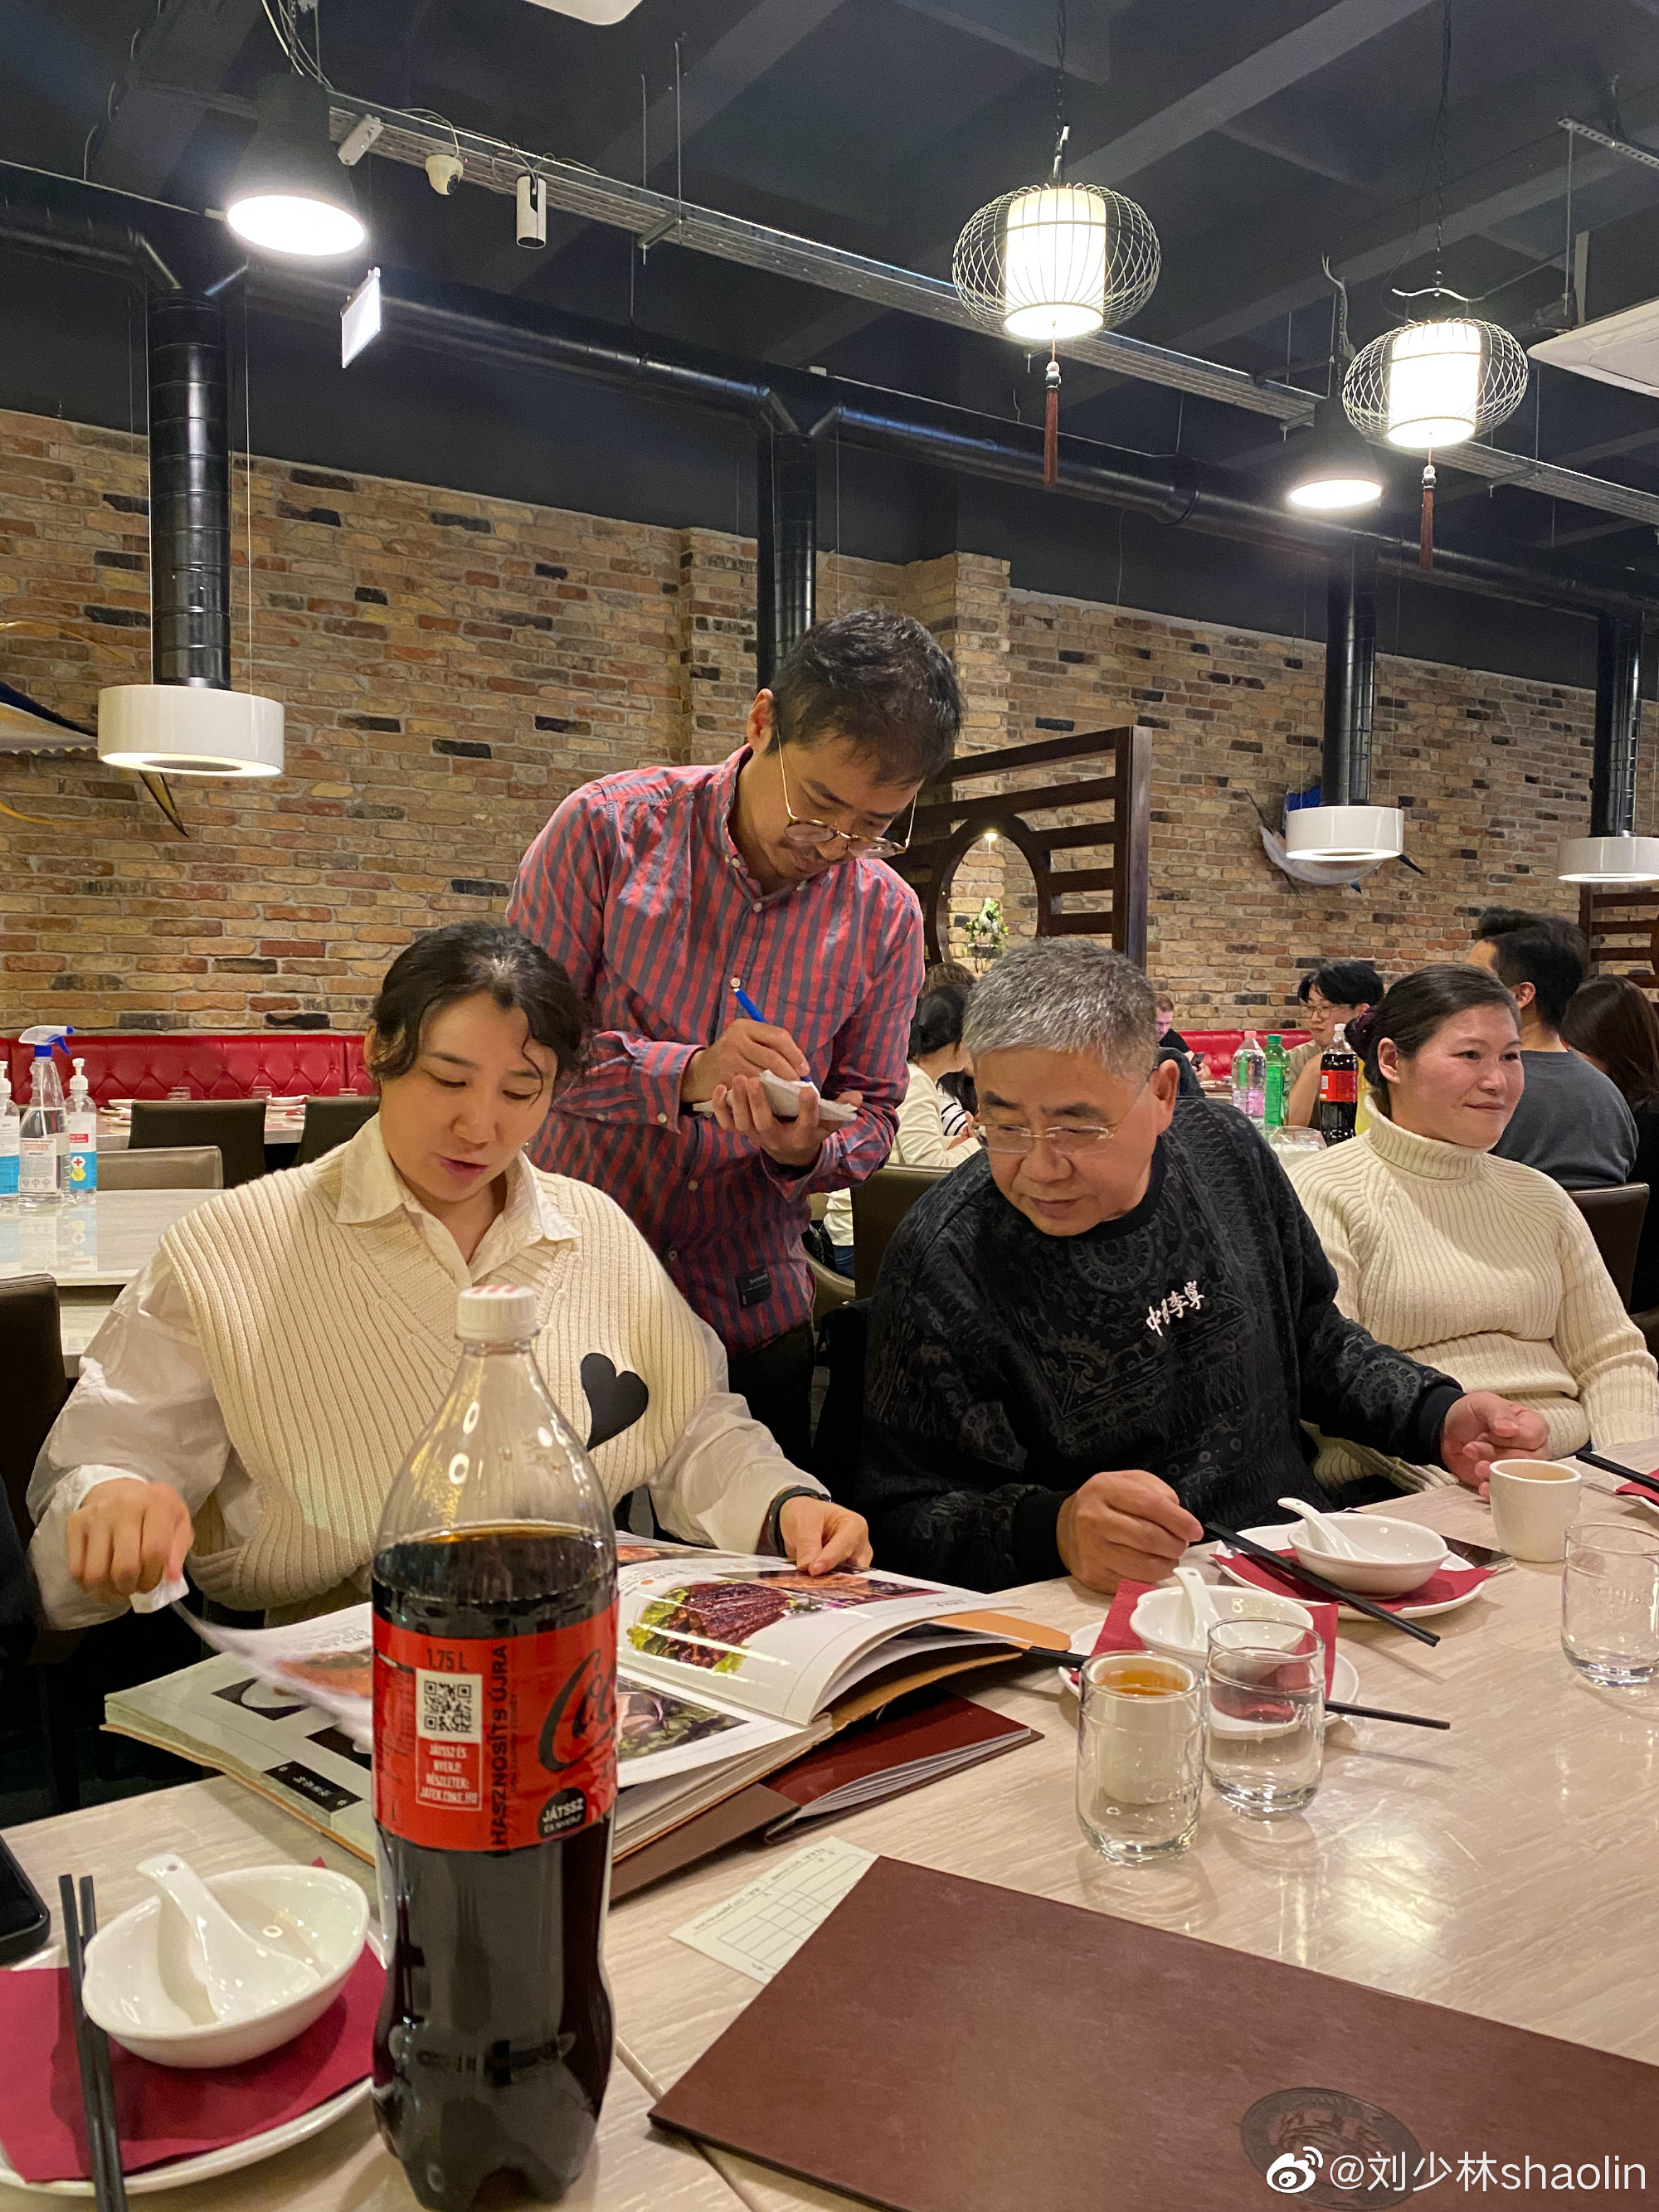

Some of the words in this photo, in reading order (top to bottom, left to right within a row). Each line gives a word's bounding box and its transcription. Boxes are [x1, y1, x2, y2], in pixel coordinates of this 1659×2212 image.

[427, 1648, 454, 1670] 1.75
[459, 1651, 468, 1671] L
[488, 1645, 508, 1702] ÚJRA
[488, 1709, 508, 1845] HASZNOSÍTS
[542, 1797, 585, 1823] JÁTSSZ
